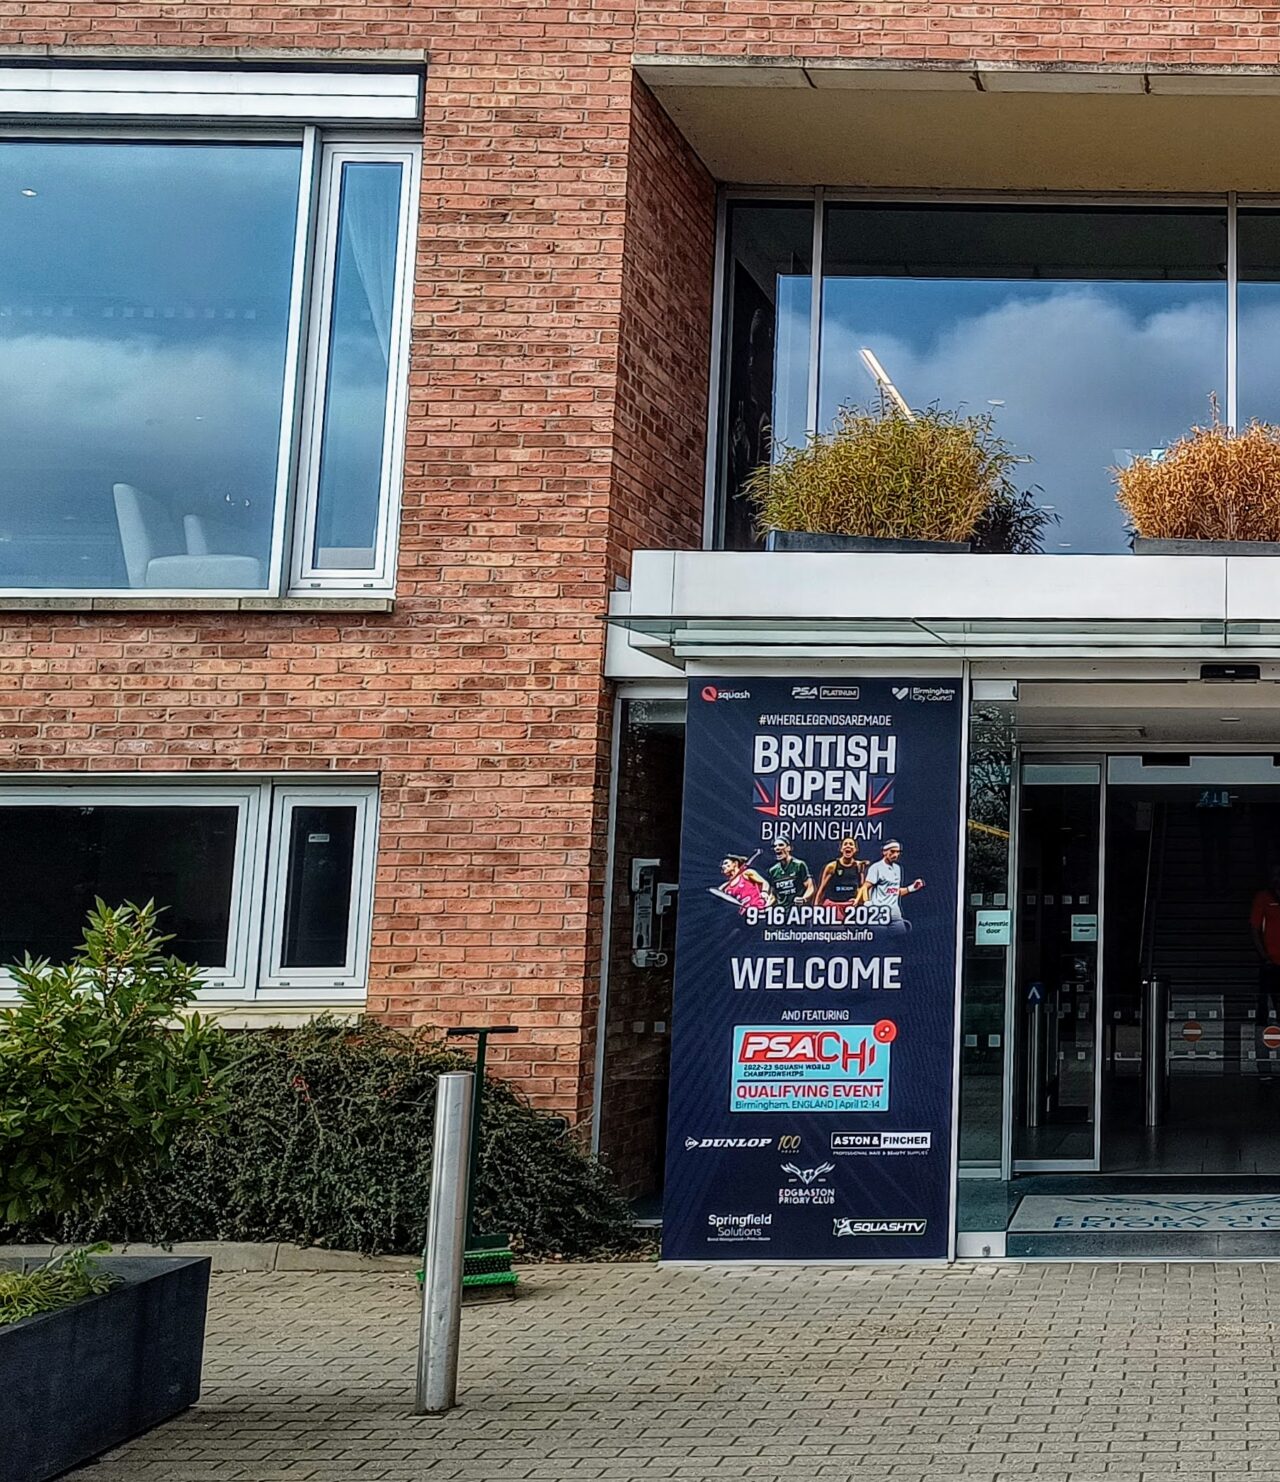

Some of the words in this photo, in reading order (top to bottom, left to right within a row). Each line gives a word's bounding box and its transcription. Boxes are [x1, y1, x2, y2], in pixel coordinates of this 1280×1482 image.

[717, 690, 750, 701] squash
[792, 687, 818, 696] PSA
[913, 687, 955, 697] Birmingham
[913, 694, 926, 702] City
[759, 714, 892, 726] #WHERELEGENDSAREMADE
[753, 735, 897, 774] BRITISH
[780, 770, 867, 801] OPEN
[779, 804, 831, 817] SQUASH
[834, 804, 866, 817] 2023
[761, 822, 882, 841] BIRMINGHAM
[746, 906, 784, 925] 9-16
[787, 906, 842, 925] APRIL
[844, 906, 890, 925] 2023
[764, 930, 873, 942] britishopensquash.info
[731, 957, 902, 990] WELCOME
[781, 1010, 799, 1021] AND
[802, 1010, 849, 1021] FEATURING
[737, 1085, 829, 1098] QUALIFYING
[833, 1085, 883, 1097] EVENT
[792, 1100, 834, 1108] ENGLAND
[839, 1100, 859, 1110] April
[860, 1100, 880, 1108] 12-14
[699, 1138, 772, 1148] DUNLOP
[777, 1135, 801, 1150] 100
[834, 1136, 870, 1145] ASTON
[871, 1136, 880, 1145] &
[883, 1136, 928, 1145] FINCHER
[778, 1189, 835, 1197] EDGBASTON
[778, 1196, 810, 1204] PRIORY
[812, 1196, 835, 1204] CLUB
[708, 1214, 772, 1227] Springfield
[718, 1227, 761, 1236] Solutions
[853, 1222, 926, 1232] SQUASHTV
